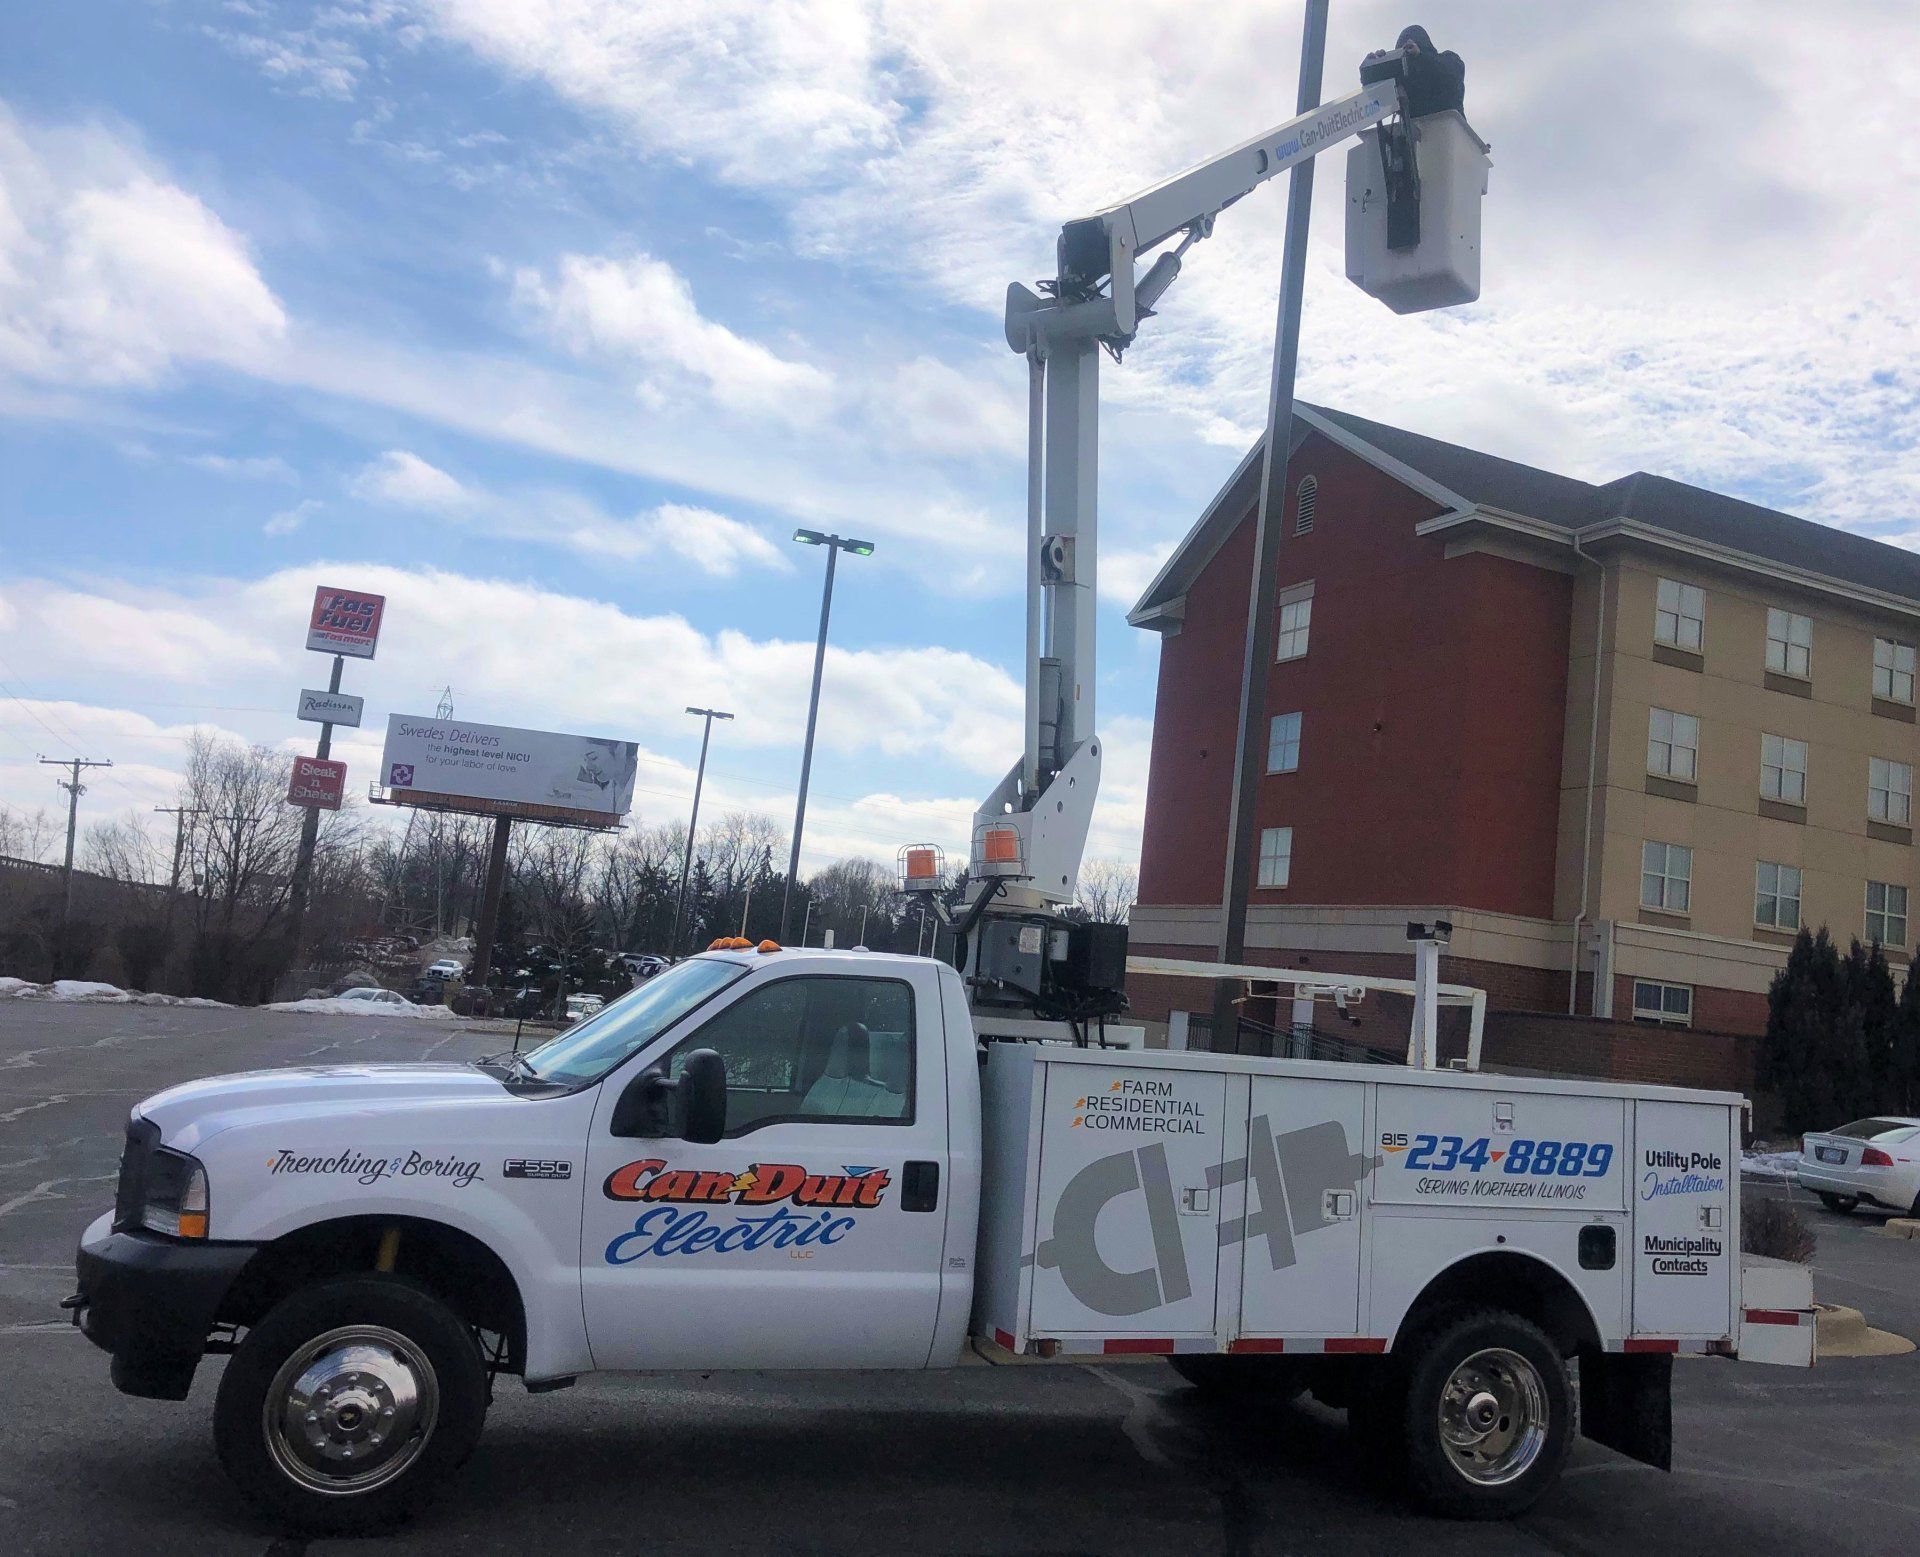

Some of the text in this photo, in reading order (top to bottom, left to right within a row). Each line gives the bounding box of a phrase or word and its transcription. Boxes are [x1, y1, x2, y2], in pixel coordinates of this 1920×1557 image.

[304, 696, 354, 712] Radisson
[398, 723, 500, 747] Swedes Delivers
[427, 743, 531, 763] the highest level NICU
[300, 762, 338, 778] Steak
[426, 754, 517, 773] for your labor of love
[293, 785, 336, 801] Shake
[1122, 1080, 1173, 1097] FARM
[1086, 1096, 1205, 1117] RESIDENTIAL
[1084, 1114, 1206, 1135] COMMERCIAL
[1381, 1133, 1409, 1147] 815
[271, 1148, 485, 1188] Trenching & Boring
[1645, 1150, 1721, 1173] Utility Pole
[1416, 1177, 1586, 1200] SERVING NORTHERN ILLINOIS
[1641, 1171, 1724, 1201] Installtaion
[604, 1205, 856, 1266] Electric
[790, 1250, 814, 1259] LLC
[1644, 1235, 1722, 1258] Municipality
[1652, 1257, 1708, 1275] Contracts
